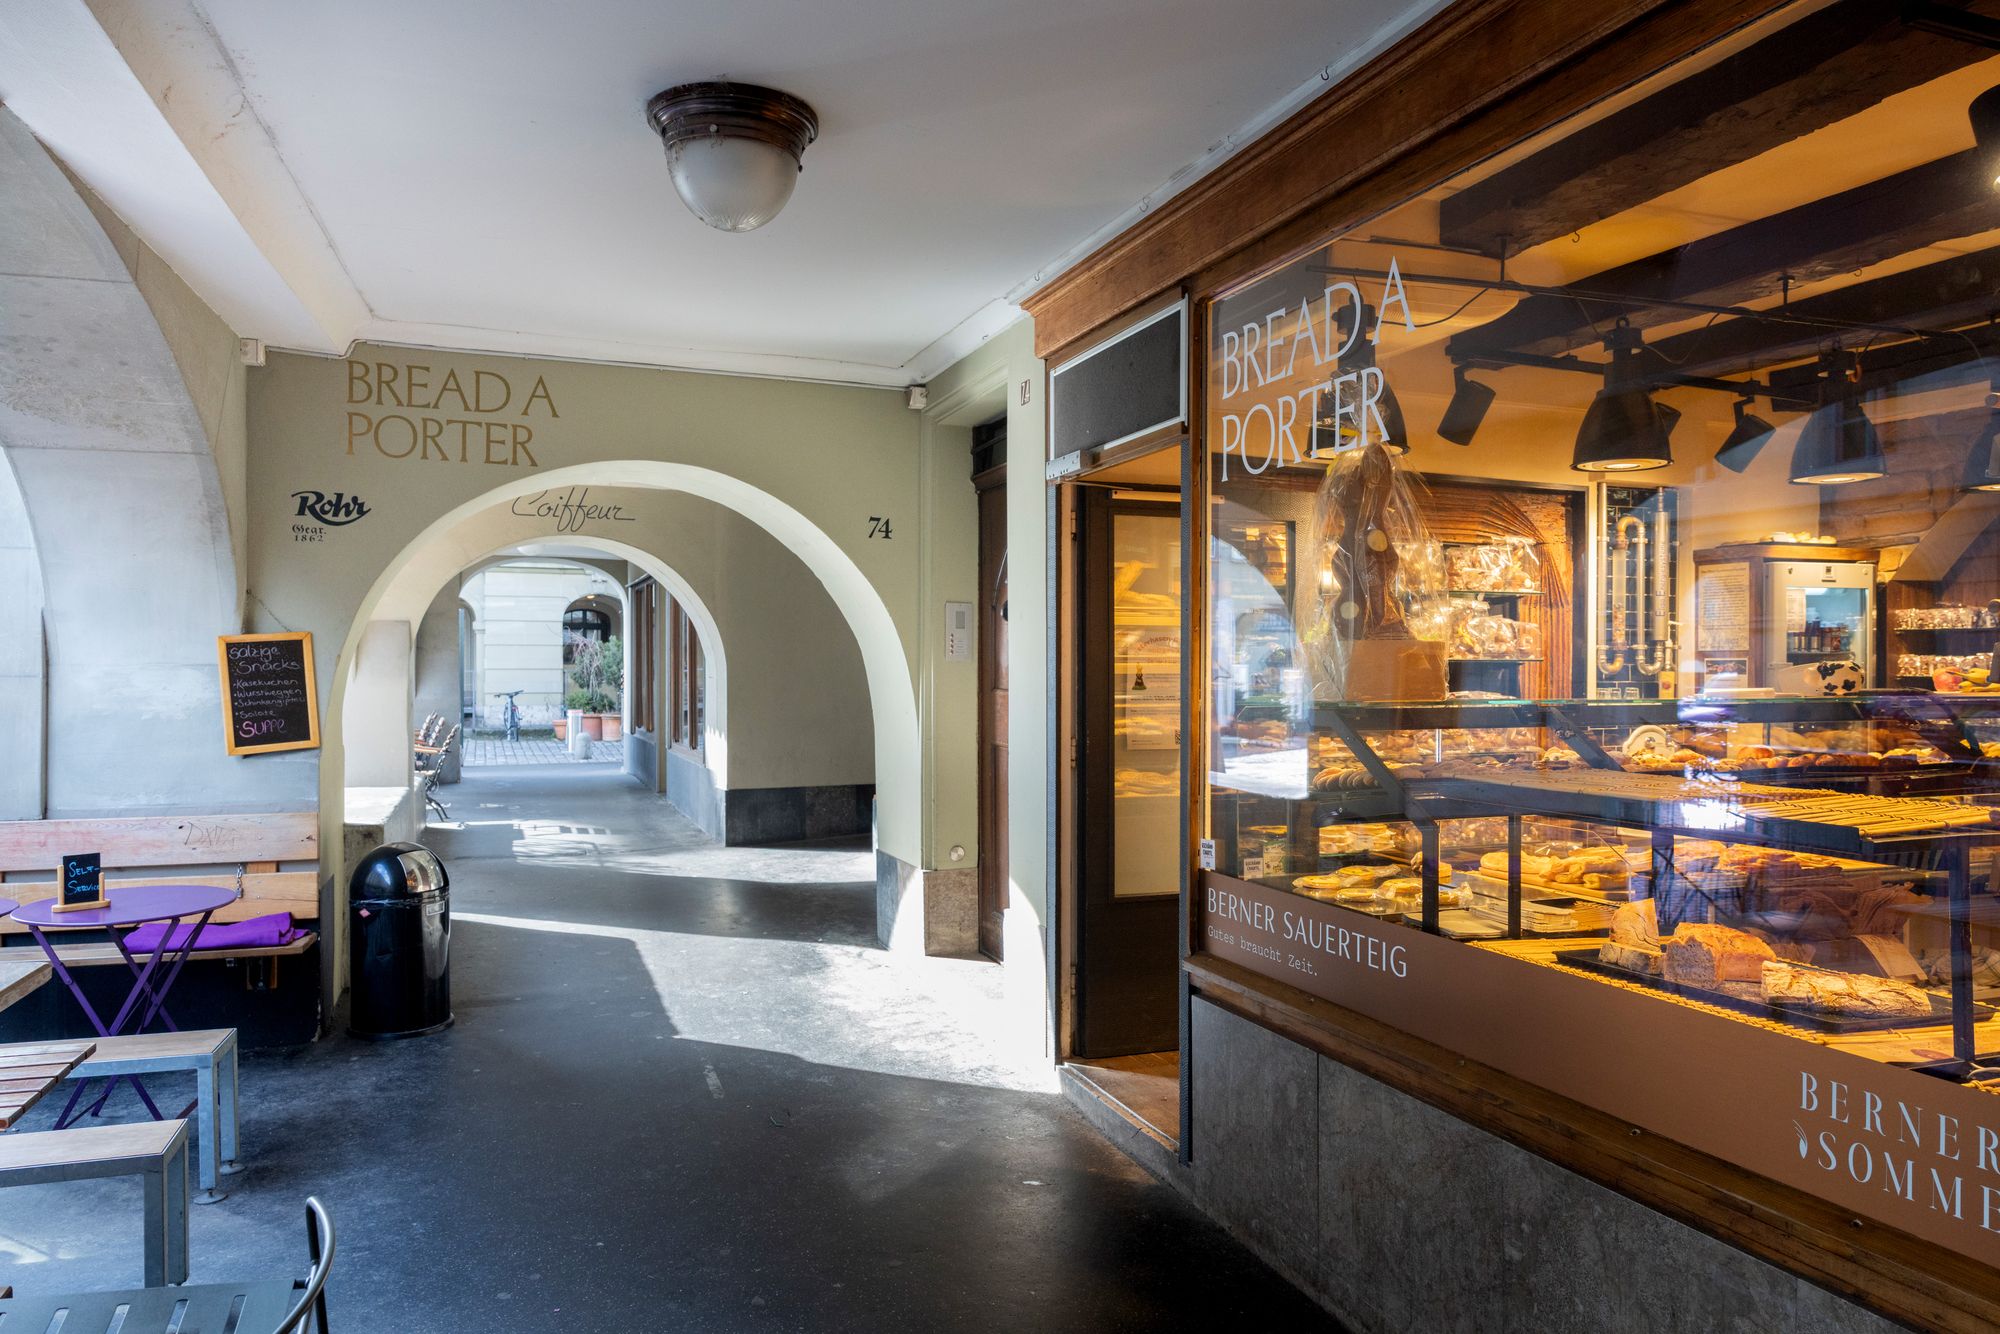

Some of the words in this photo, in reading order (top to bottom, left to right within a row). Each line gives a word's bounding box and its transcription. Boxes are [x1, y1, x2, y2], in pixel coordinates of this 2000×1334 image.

[1222, 282, 1362, 400] BREAD
[1371, 256, 1417, 345] A
[347, 360, 512, 413] BREAD
[521, 375, 560, 418] A
[346, 412, 539, 467] PORTER
[1221, 367, 1391, 483] PORTER
[291, 490, 372, 526] Rohr
[512, 487, 636, 532] Coiffeur
[868, 516, 893, 539] 74
[295, 534, 324, 542] 1862
[237, 659, 301, 675] Snacks
[1207, 887, 1276, 934] BERNER
[1283, 911, 1408, 978] SAUERTEIG
[1207, 926, 1235, 945] Gutes
[1240, 936, 1282, 963] braucht
[1288, 954, 1318, 977] Zeit.
[1800, 1070, 2000, 1175] BERNER
